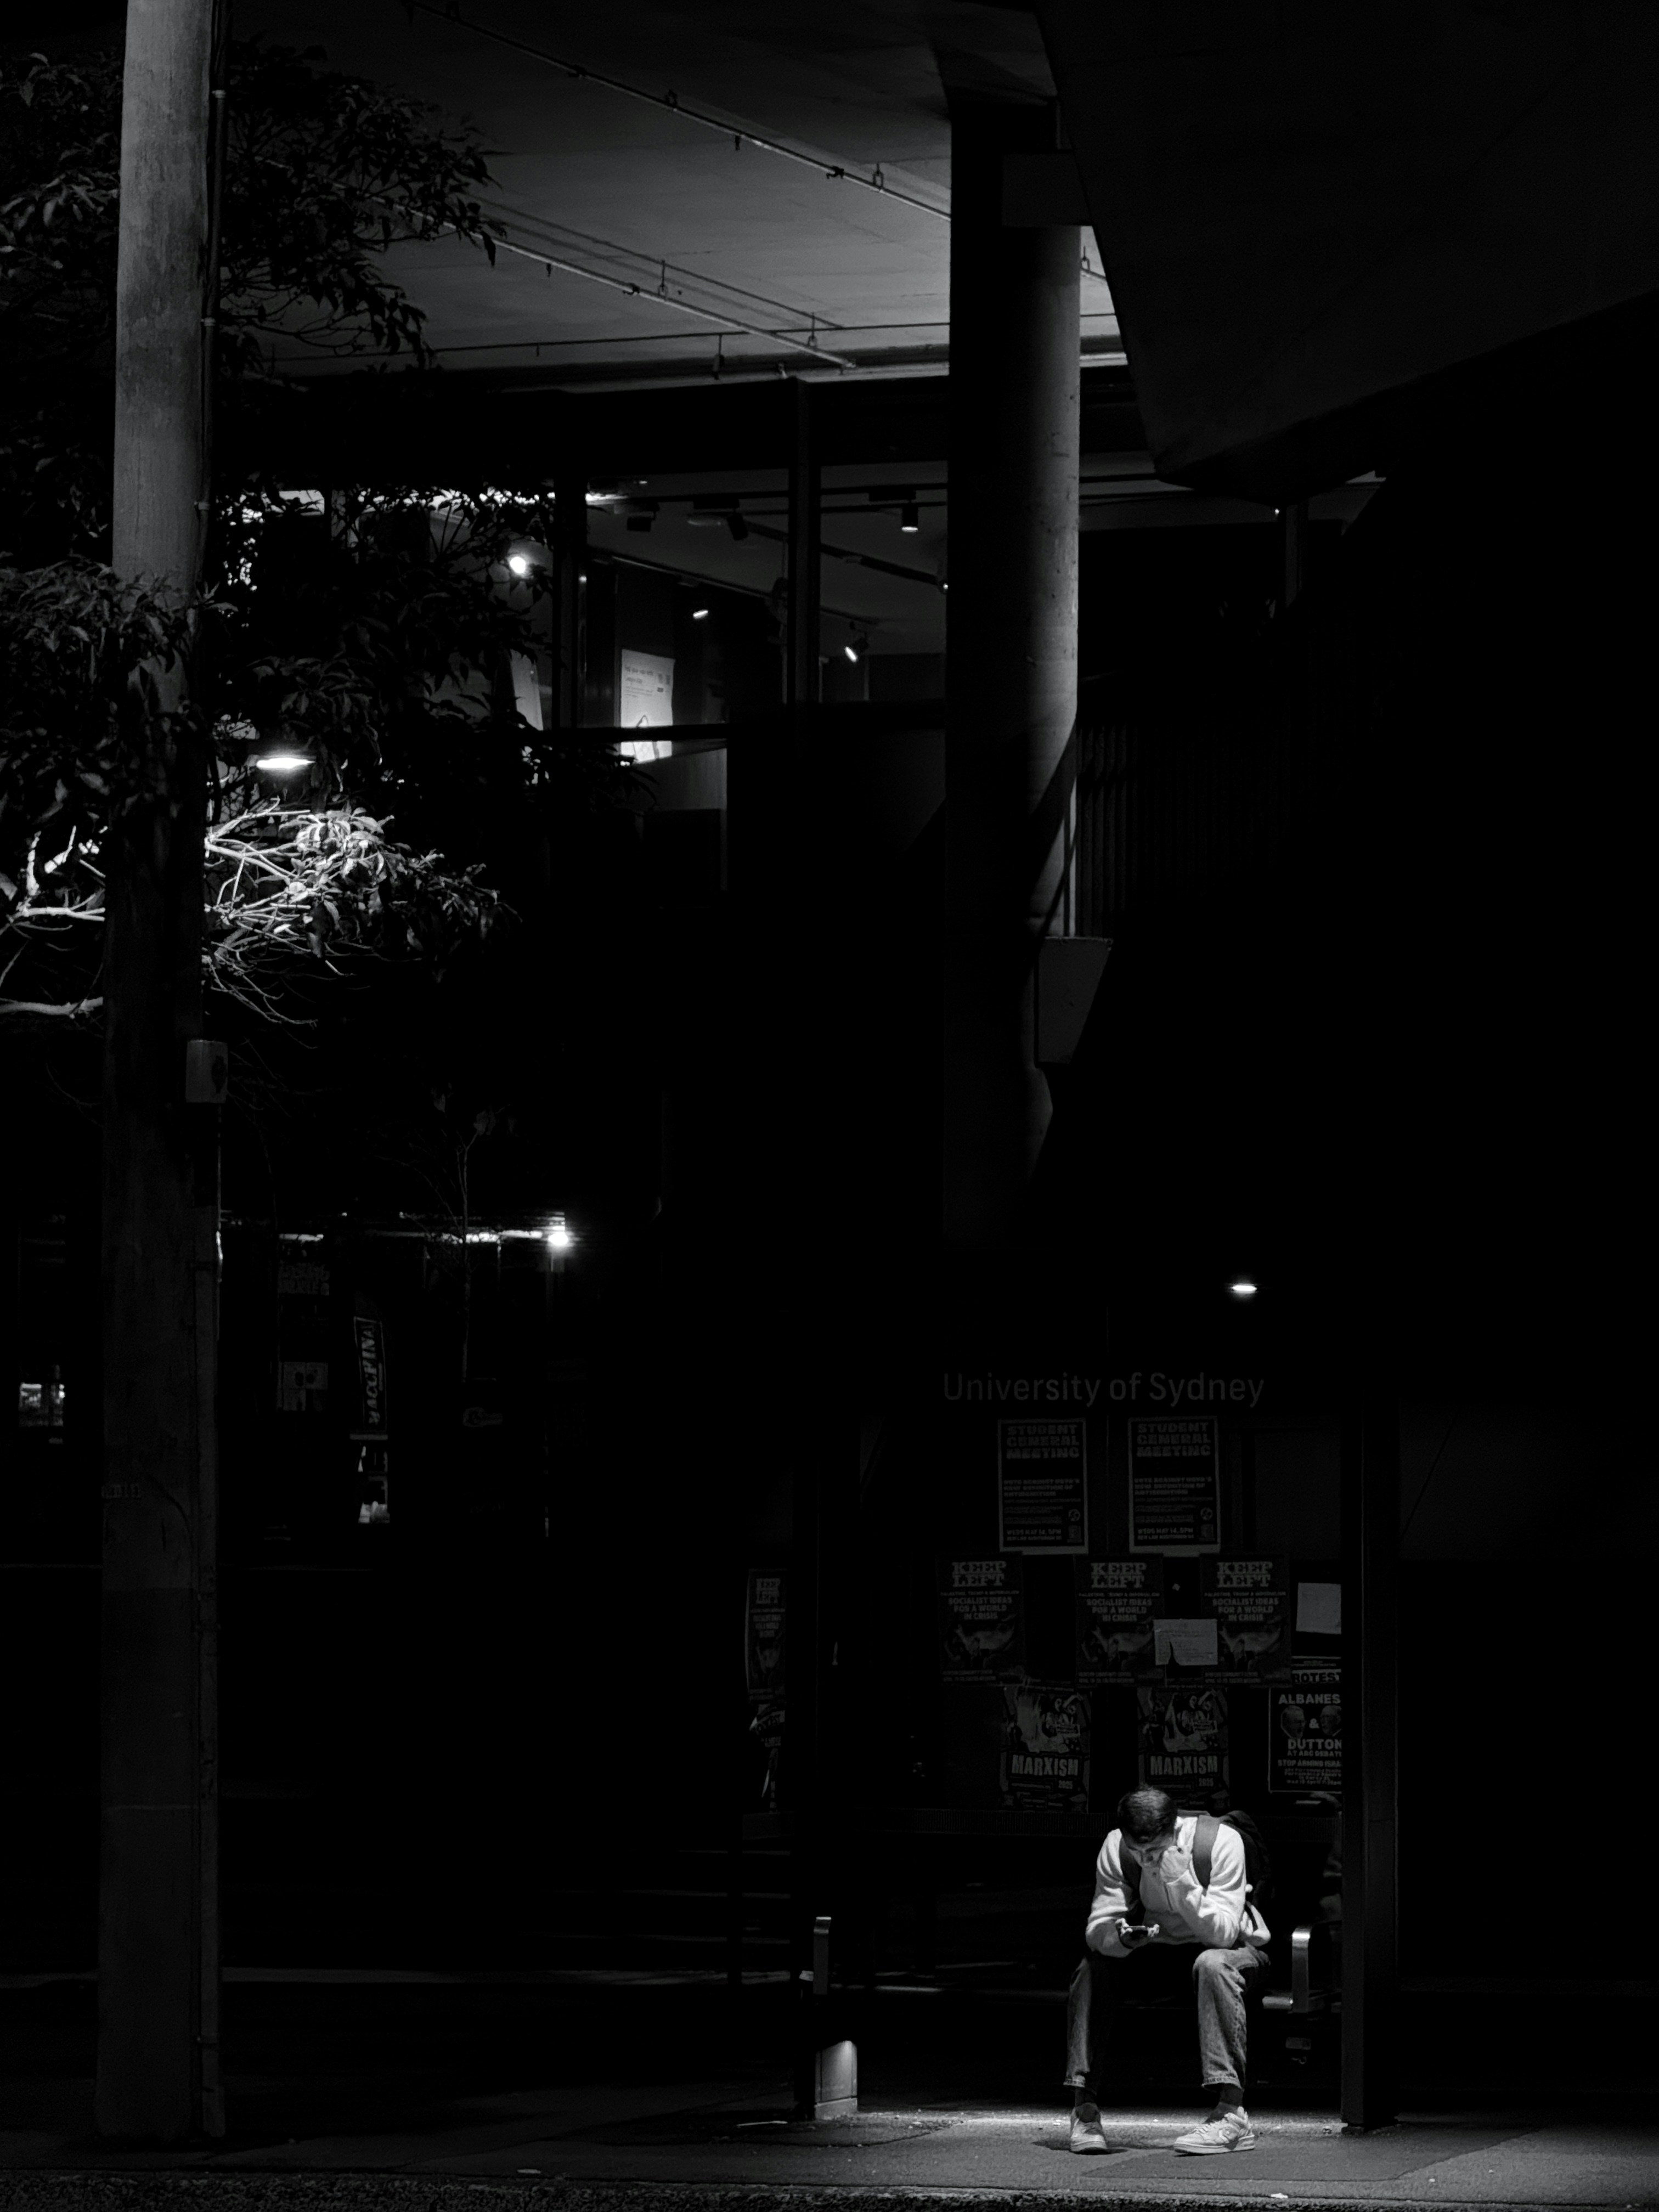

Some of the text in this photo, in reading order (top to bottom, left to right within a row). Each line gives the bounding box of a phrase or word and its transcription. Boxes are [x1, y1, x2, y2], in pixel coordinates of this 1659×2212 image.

[943, 1372, 1265, 1408] University of Sydney
[1007, 1425, 1078, 1435] STUDENT
[1137, 1422, 1209, 1434] STUDENT
[1137, 1434, 1211, 1445] GENERAL
[1006, 1447, 1080, 1459] MEETING
[1136, 1445, 1211, 1458] MEETING
[951, 1560, 1007, 1574] KEEP
[1090, 1562, 1148, 1575] KEEP
[1216, 1561, 1273, 1574] KEEP
[952, 1573, 1005, 1587] LEFT
[1091, 1575, 1145, 1588] LEFT
[1216, 1573, 1271, 1588] LEFT
[948, 1597, 988, 1605] SOCIALIST
[1086, 1598, 1128, 1606] SOCIALIST
[1212, 1598, 1254, 1606] SOCIALIST
[953, 1605, 969, 1613] FOR
[1117, 1606, 1147, 1614] WORLD
[974, 1612, 998, 1620] CRISIS
[1278, 1694, 1341, 1705] ALBANES
[1308, 1718, 1320, 1729] &
[1288, 1738, 1342, 1750] DUTTON
[1011, 1754, 1079, 1777] MARXISM
[1150, 1755, 1218, 1776] MARXISM
[1198, 1778, 1214, 1787] 2025
